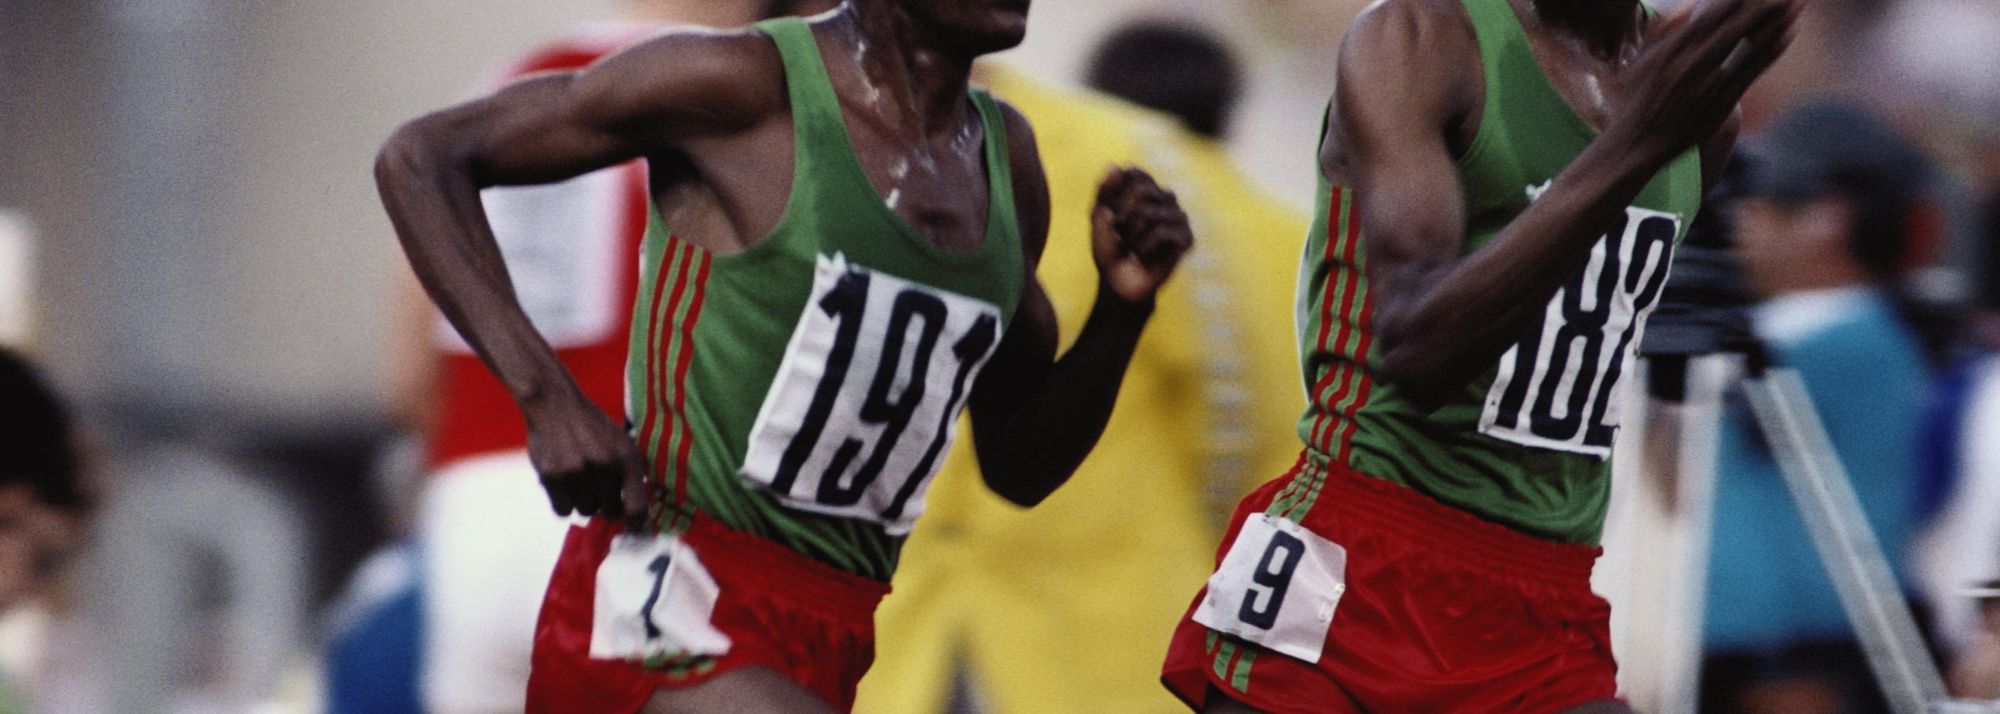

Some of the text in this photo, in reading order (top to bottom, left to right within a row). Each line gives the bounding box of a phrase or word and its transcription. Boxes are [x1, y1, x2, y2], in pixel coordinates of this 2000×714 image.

[771, 271, 997, 520] 191
[642, 554, 671, 639] 1
[1238, 529, 1305, 631] 9
